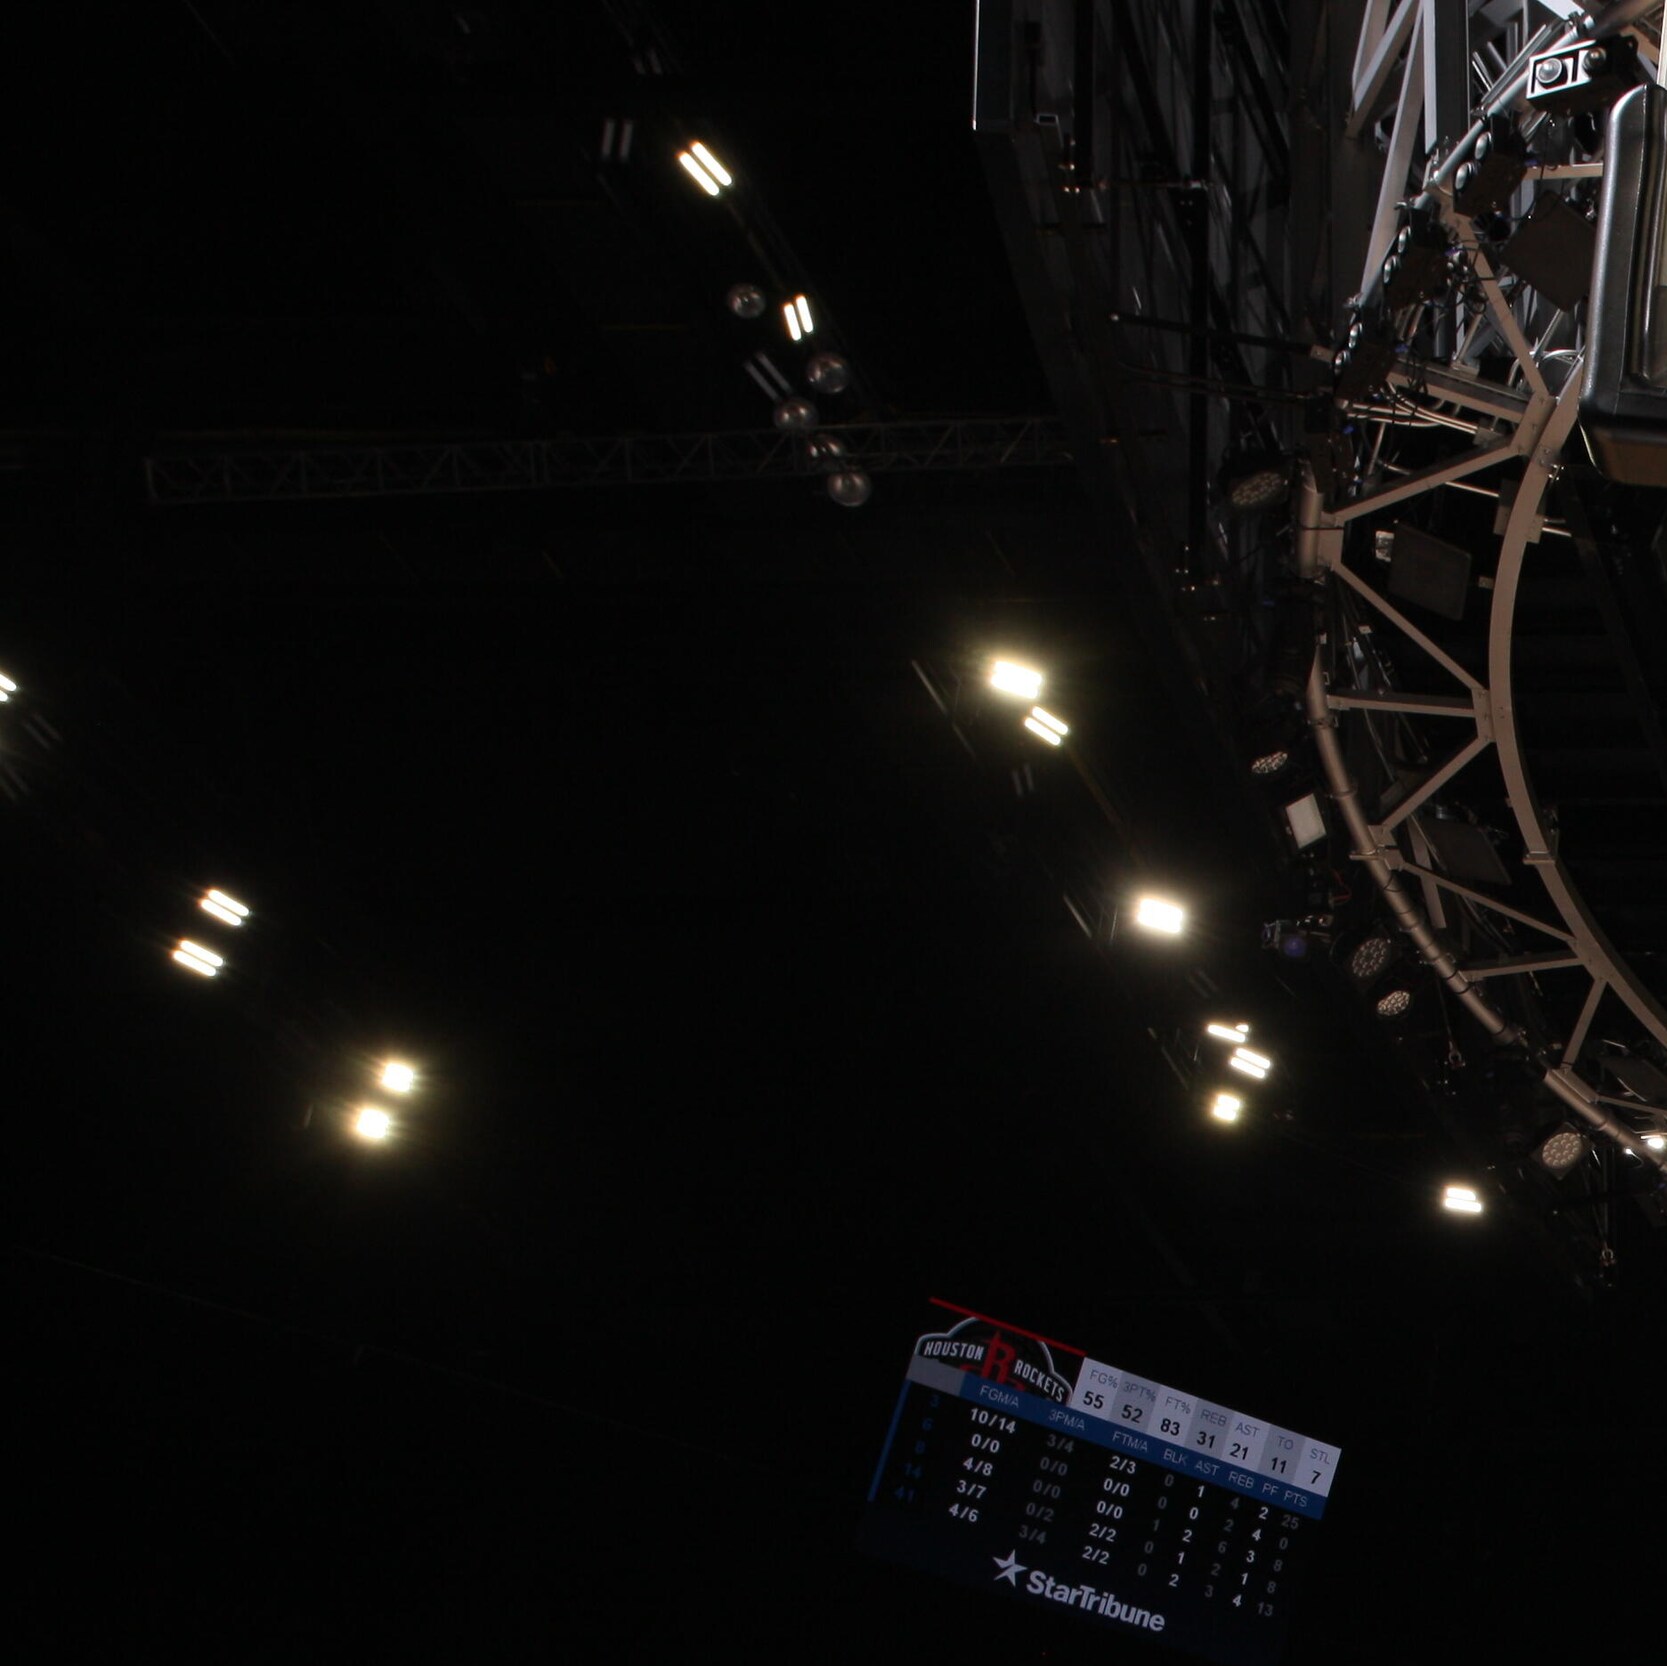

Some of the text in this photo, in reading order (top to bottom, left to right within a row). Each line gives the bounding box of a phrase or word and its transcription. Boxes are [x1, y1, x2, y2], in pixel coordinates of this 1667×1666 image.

[923, 1341, 1065, 1403] HOUSTON ROCKETS
[970, 1407, 1136, 1475] 10/14 2/3
[971, 1433, 1000, 1453] 0/0
[1083, 1391, 1321, 1484] 55 52 83 31 21 11 7
[1200, 1409, 1226, 1427] REB
[1235, 1422, 1260, 1438] AST
[1277, 1436, 1294, 1450] TO
[1310, 1448, 1330, 1465] STL
[956, 1479, 987, 1499] 3/7
[962, 1456, 993, 1476] 4/8
[1163, 1448, 1188, 1466] BLK
[1194, 1460, 1220, 1477] AST
[1228, 1470, 1254, 1489] REB
[1262, 1482, 1279, 1496] PF
[948, 1503, 979, 1522] 4/6
[1026, 1569, 1167, 1631] StarTribune
